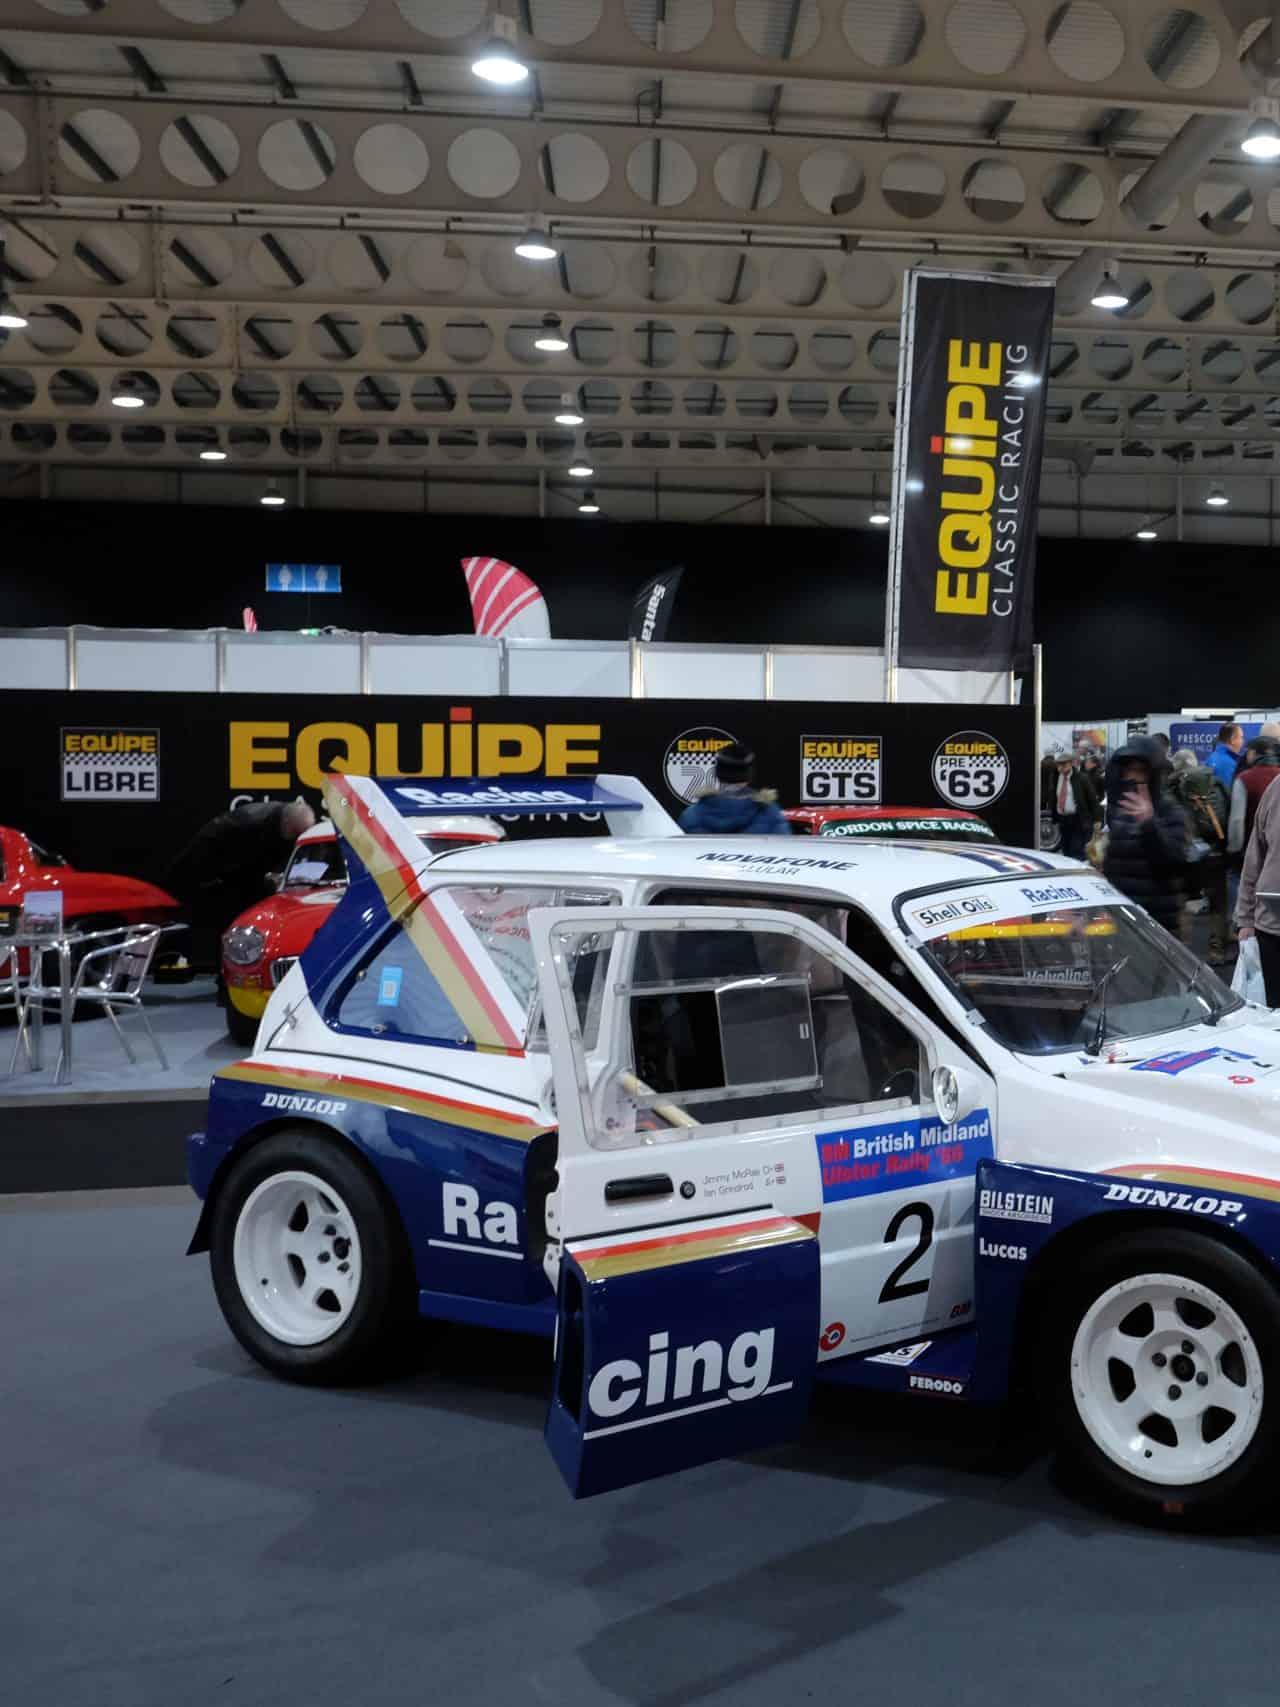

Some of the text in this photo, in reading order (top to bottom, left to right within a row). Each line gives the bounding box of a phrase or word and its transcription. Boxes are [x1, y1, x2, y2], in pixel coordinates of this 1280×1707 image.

[993, 343, 1029, 616] CLASSIC RACING
[1177, 734, 1217, 744] PRESCO
[940, 757, 966, 768] PRE
[66, 771, 155, 792] LIBRE
[805, 771, 876, 799] GTS
[823, 820, 995, 837] GORDON SPICE RACING
[696, 852, 860, 871] NOVAFONE
[1020, 885, 1083, 902] Racing
[920, 898, 993, 925] Shell Oils
[261, 1092, 347, 1116] DUNLOP
[853, 1131, 915, 1159] British
[920, 1118, 989, 1147] Midland
[980, 1189, 1054, 1215] BILSTEIN
[1104, 1183, 1244, 1217] DUNLOP
[443, 1181, 519, 1245] Ra
[878, 1202, 935, 1304] 2
[979, 1237, 1028, 1261] Lucas
[588, 1326, 776, 1418] cing
[910, 1375, 963, 1395] FERODO
